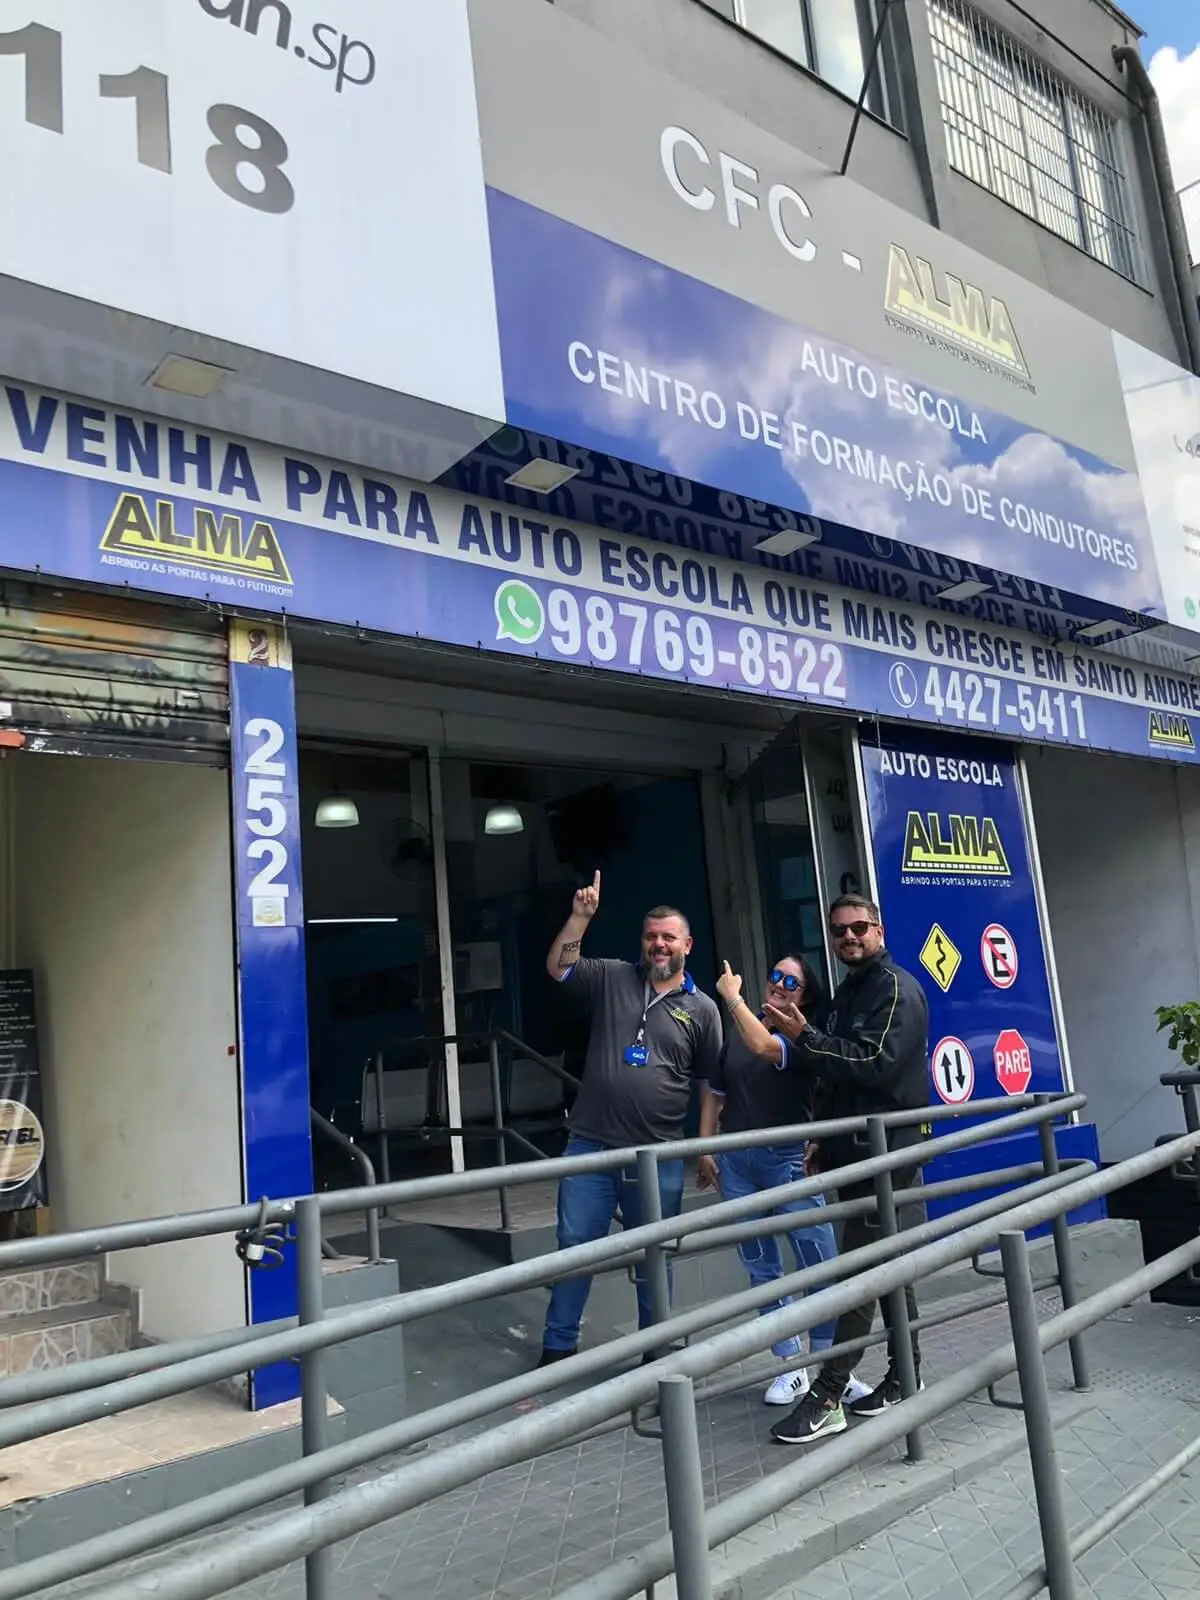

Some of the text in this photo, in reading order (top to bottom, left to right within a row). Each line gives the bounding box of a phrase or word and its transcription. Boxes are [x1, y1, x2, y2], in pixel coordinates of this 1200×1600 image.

[660, 124, 818, 263] CFC
[884, 241, 1031, 379] ALMA
[800, 341, 878, 399] AUTO
[884, 375, 988, 444] ESCOLA
[568, 341, 1138, 571] CENTRO DE FORMAÇÃO DE CONDUTORES
[5, 387, 261, 503] VENHA
[285, 457, 440, 546] PARA
[458, 504, 583, 576] AUTO
[600, 538, 753, 615] ESCOLA
[764, 580, 833, 633] QUE
[842, 598, 917, 651] MAIS
[925, 620, 1026, 674] CRESCE
[1031, 645, 1067, 683] EM
[1072, 655, 1137, 699] SANTO
[98, 491, 294, 585] ALMA
[100, 554, 150, 572] ABRINDO
[151, 560, 166, 575] AS
[168, 565, 208, 583] PORTAS
[210, 573, 236, 587] PARA
[238, 579, 246, 589] O
[547, 588, 847, 700] 98769-8522
[924, 666, 1088, 740] 4427-5411
[1148, 710, 1196, 749] ALMA
[880, 750, 1004, 788] AUTO ESCOLA
[902, 810, 1012, 876] ALMA
[901, 875, 931, 886] ABRINDO
[931, 876, 941, 886] AS
[941, 877, 966, 887] PORTAS
[995, 1049, 1030, 1077] PARE
